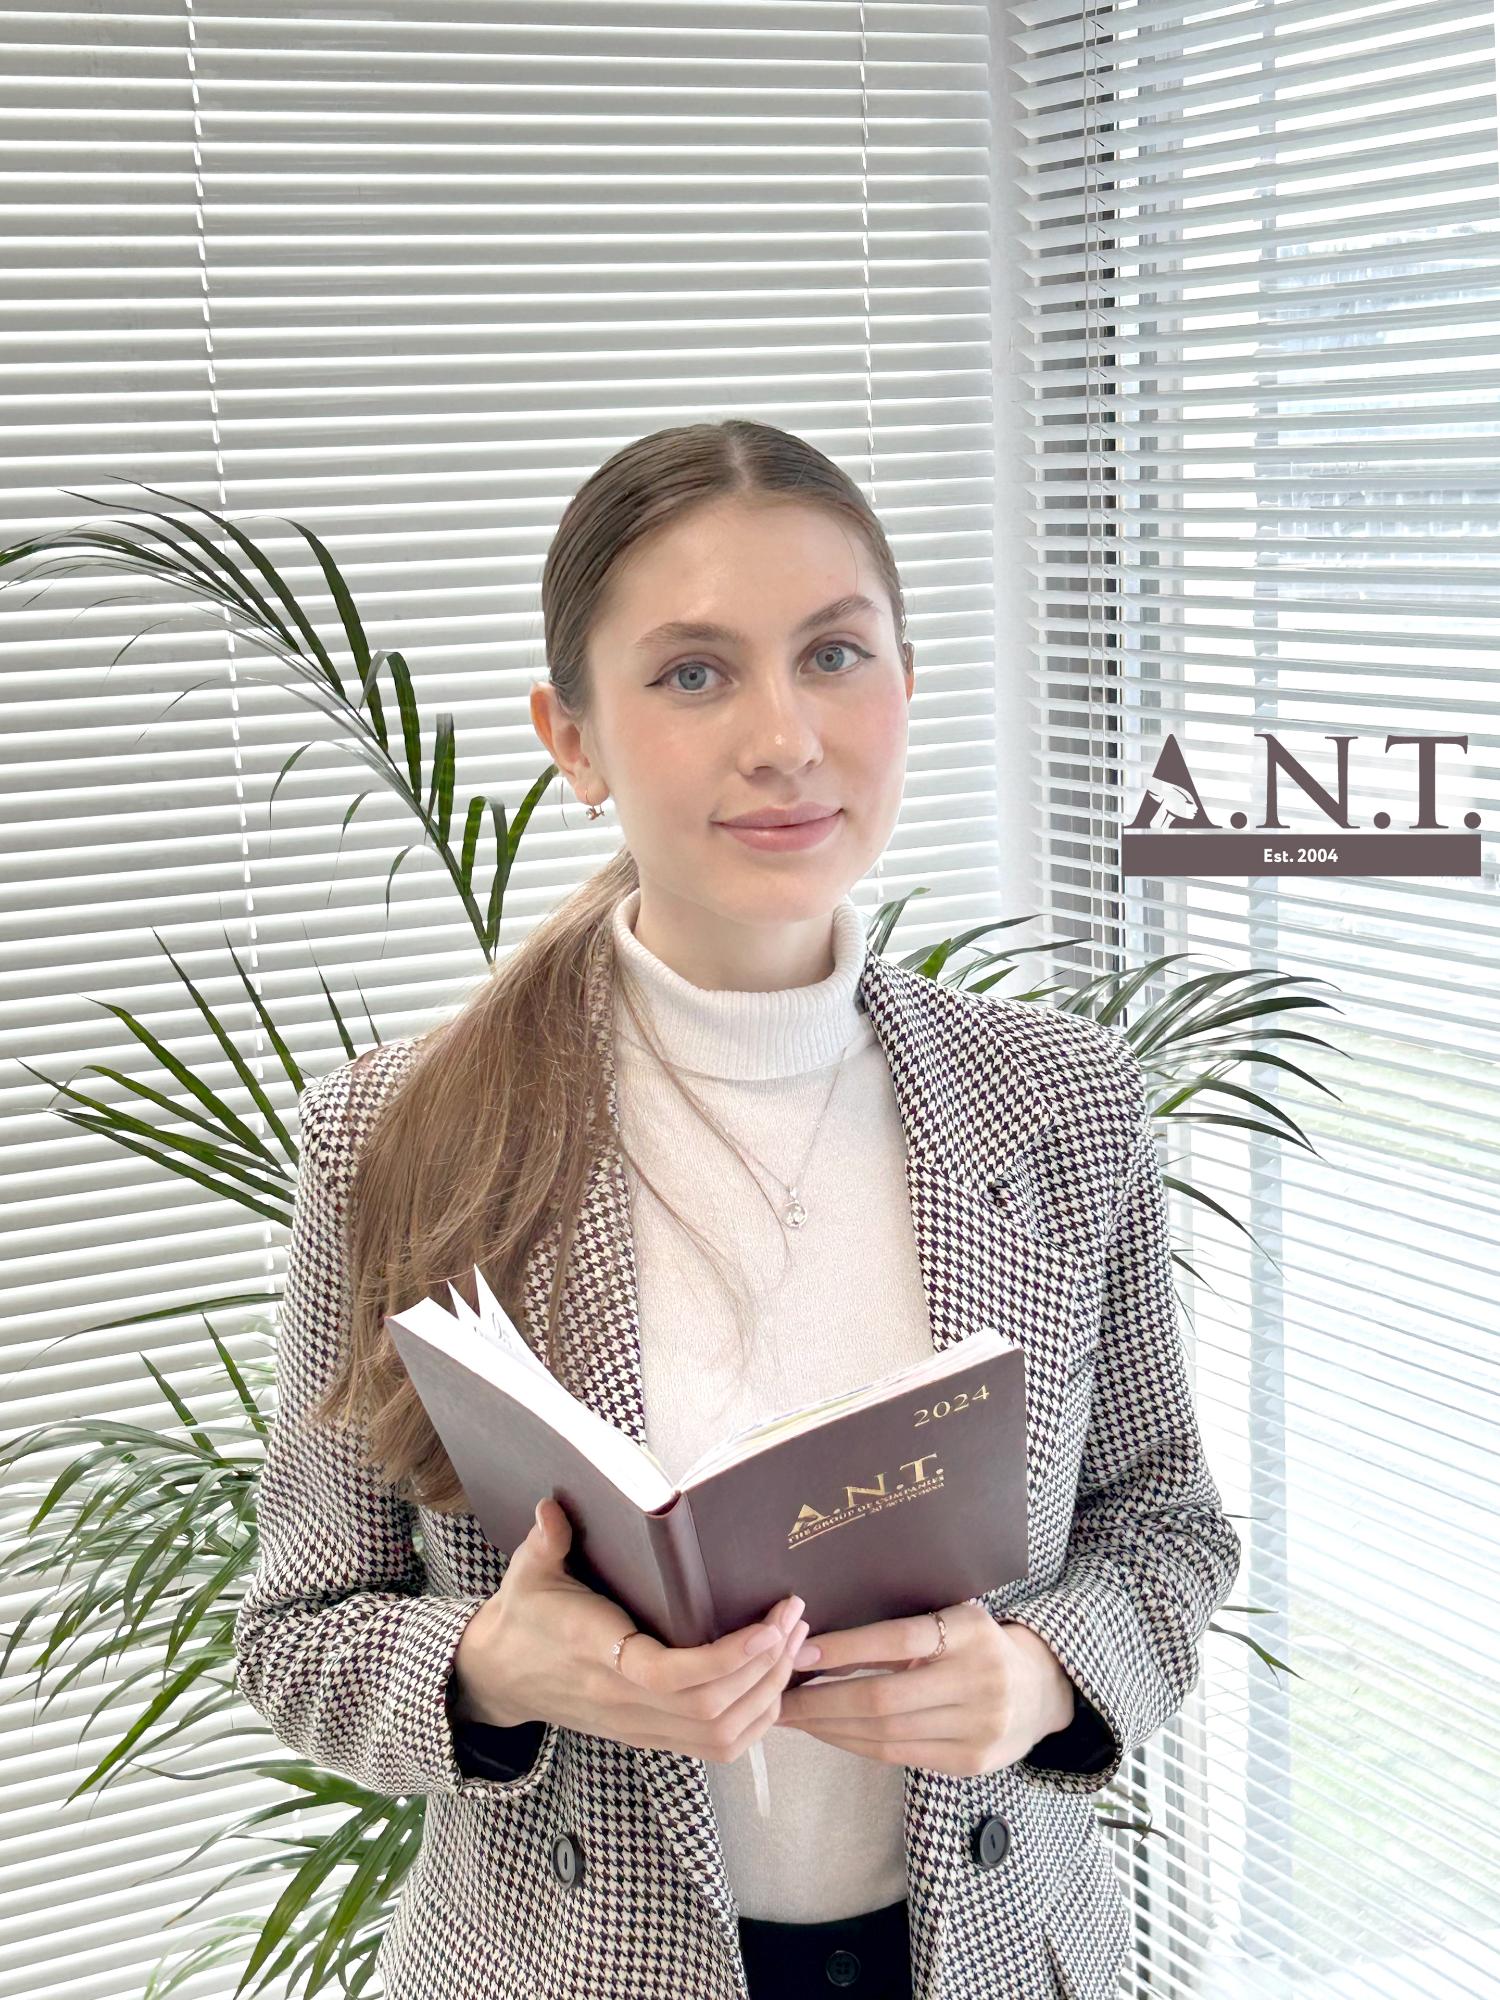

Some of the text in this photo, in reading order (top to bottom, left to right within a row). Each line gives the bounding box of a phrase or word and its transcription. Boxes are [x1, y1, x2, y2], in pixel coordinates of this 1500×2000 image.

[913, 1383, 991, 1427] 2024
[787, 1453, 945, 1537] A.N.T.
[787, 1527, 811, 1544] THE
[812, 1507, 856, 1532] GROUP
[857, 1501, 874, 1515] OF
[875, 1474, 945, 1506] COMPANIES
